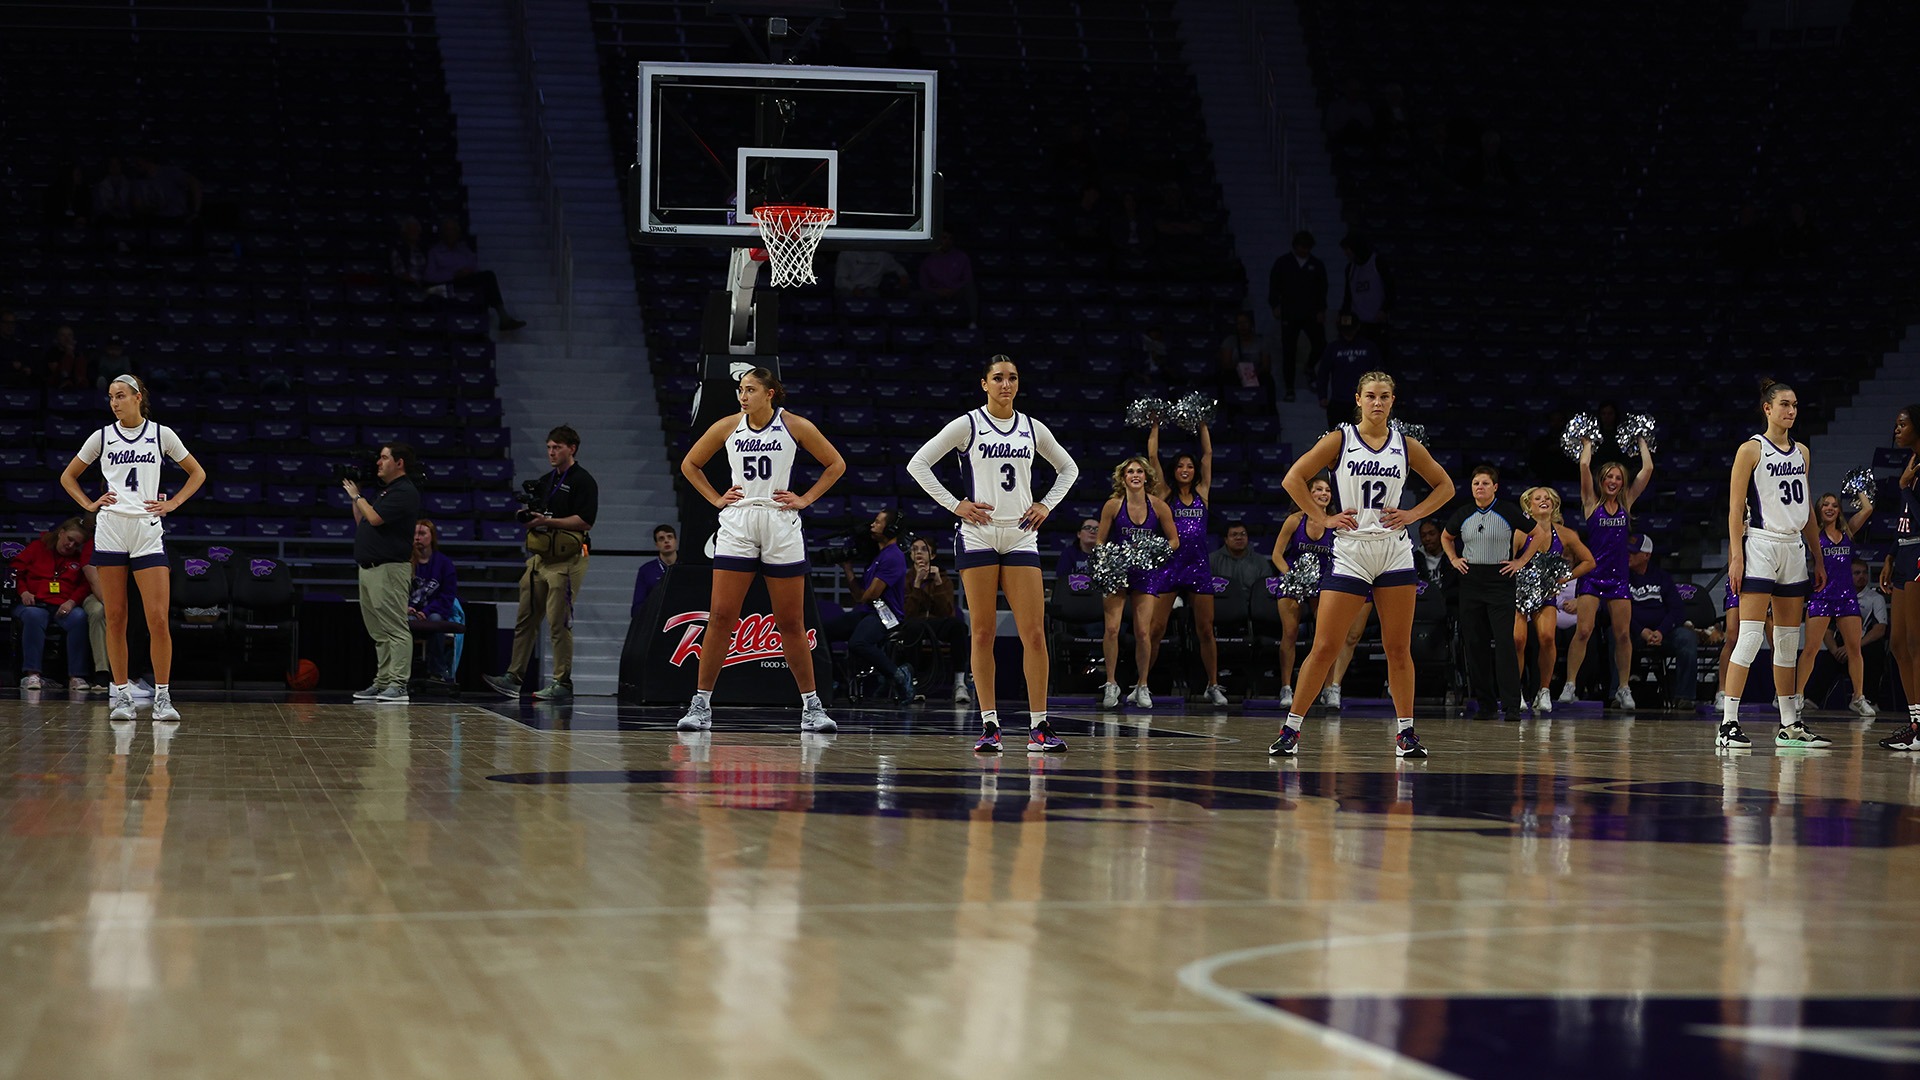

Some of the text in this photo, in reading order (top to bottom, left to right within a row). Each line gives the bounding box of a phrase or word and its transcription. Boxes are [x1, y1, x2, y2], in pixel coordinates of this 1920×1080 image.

[735, 439, 782, 452] Wildcats
[978, 443, 1031, 459] Wildcats
[107, 450, 156, 465] Wildcats
[743, 455, 772, 481] 50
[1347, 460, 1401, 479] Wildcats
[1766, 461, 1806, 477] Wildcat
[125, 467, 139, 492] 4
[1000, 463, 1016, 492] 3
[1361, 480, 1387, 509] 12
[1779, 479, 1804, 505] 30
[1175, 508, 1203, 517] K-STATE
[1599, 518, 1626, 526] K-STATE
[1823, 546, 1851, 556] K-STATE
[663, 611, 817, 667] Dllos
[761, 661, 780, 669] FOOD
